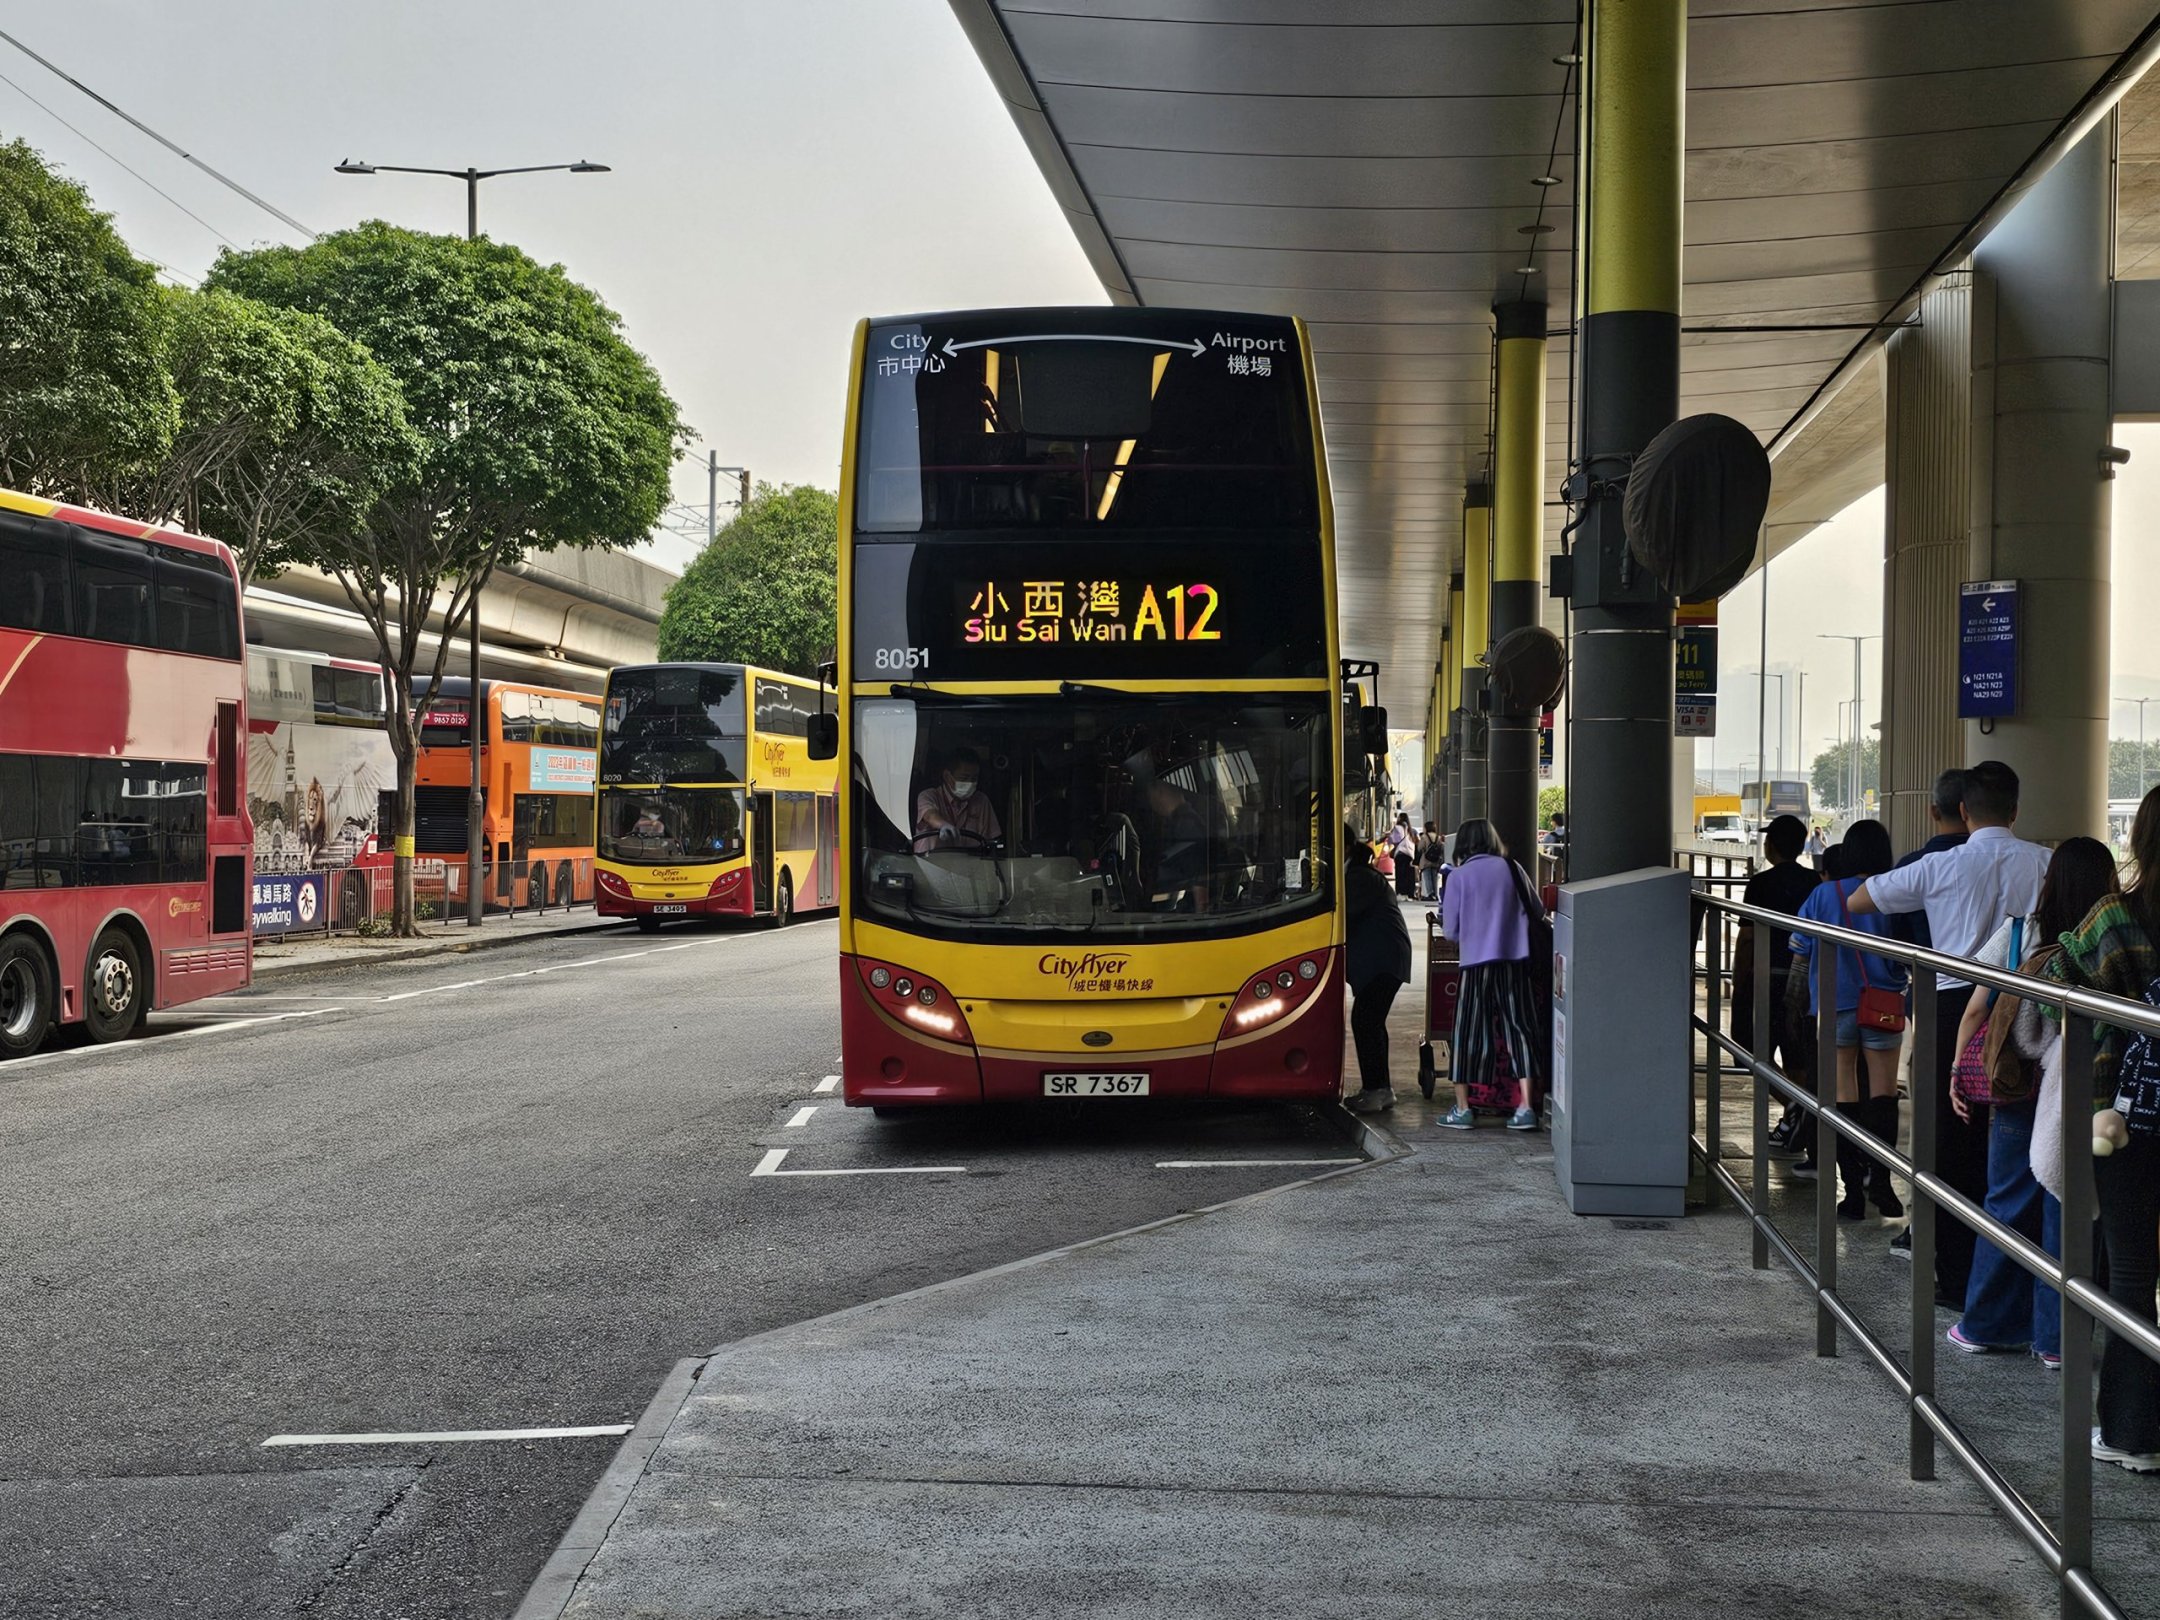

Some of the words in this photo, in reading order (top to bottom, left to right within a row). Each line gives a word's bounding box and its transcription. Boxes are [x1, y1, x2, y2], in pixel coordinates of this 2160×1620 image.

[890, 333, 933, 353] City
[1210, 331, 1287, 354] Airport
[877, 354, 946, 377] 市中心
[1227, 353, 1272, 377] 機場
[970, 581, 1120, 619] 小西灣
[1133, 583, 1221, 641] A12
[964, 618, 1007, 642] Siu
[1017, 618, 1060, 642] Sai
[1070, 617, 1126, 642] Wan
[874, 647, 930, 670] 8051
[1038, 952, 1132, 990] Cityflyer
[1073, 978, 1154, 992] 城巴機場快線
[1051, 1076, 1078, 1094] SR
[1088, 1076, 1144, 1094] 7367
